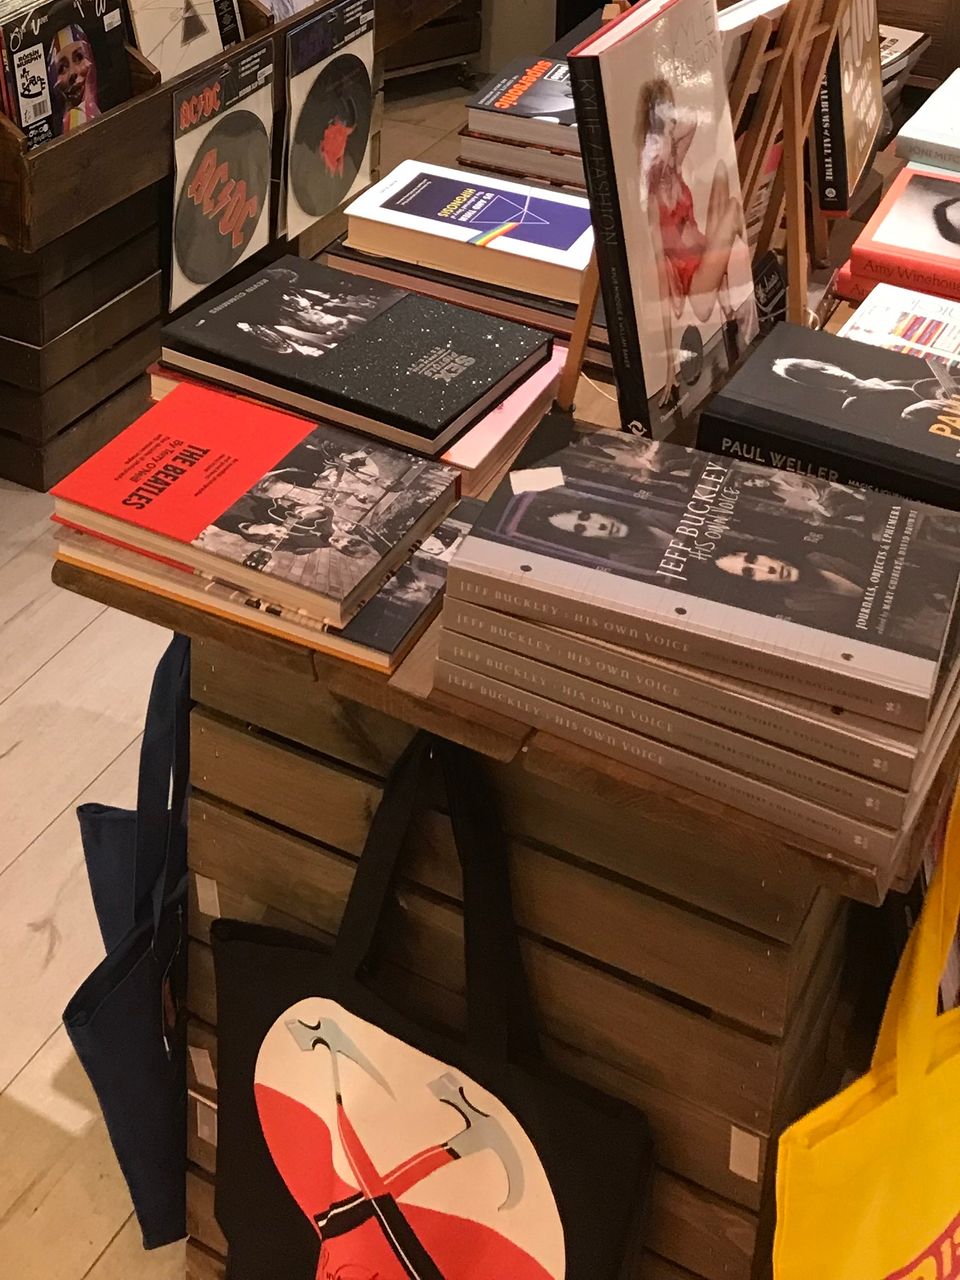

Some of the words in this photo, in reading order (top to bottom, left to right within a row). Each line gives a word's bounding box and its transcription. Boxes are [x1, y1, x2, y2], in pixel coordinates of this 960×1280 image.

[820, 89, 830, 129] ALBUMS
[823, 136, 832, 157] ALL
[824, 157, 834, 183] TIME
[864, 260, 894, 277] Amy
[440, 354, 476, 383] SEX
[151, 446, 177, 465] Terry
[168, 438, 184, 450] By
[171, 443, 211, 468] THE
[721, 436, 765, 463] PAUL
[769, 450, 840, 484] WELLER
[121, 463, 187, 511] BEATLES
[655, 539, 693, 582] JEFF
[675, 461, 729, 539] BUCKLEY
[688, 540, 717, 562] HIS
[714, 484, 741, 519] VOICE
[869, 549, 890, 586] OBJECTS
[882, 505, 902, 545] EPHEMERA
[460, 580, 490, 596] JEFF
[494, 590, 559, 616] BUCKLEY
[574, 613, 599, 628] HIS
[603, 620, 640, 639] OWN
[644, 631, 691, 653] VOICE
